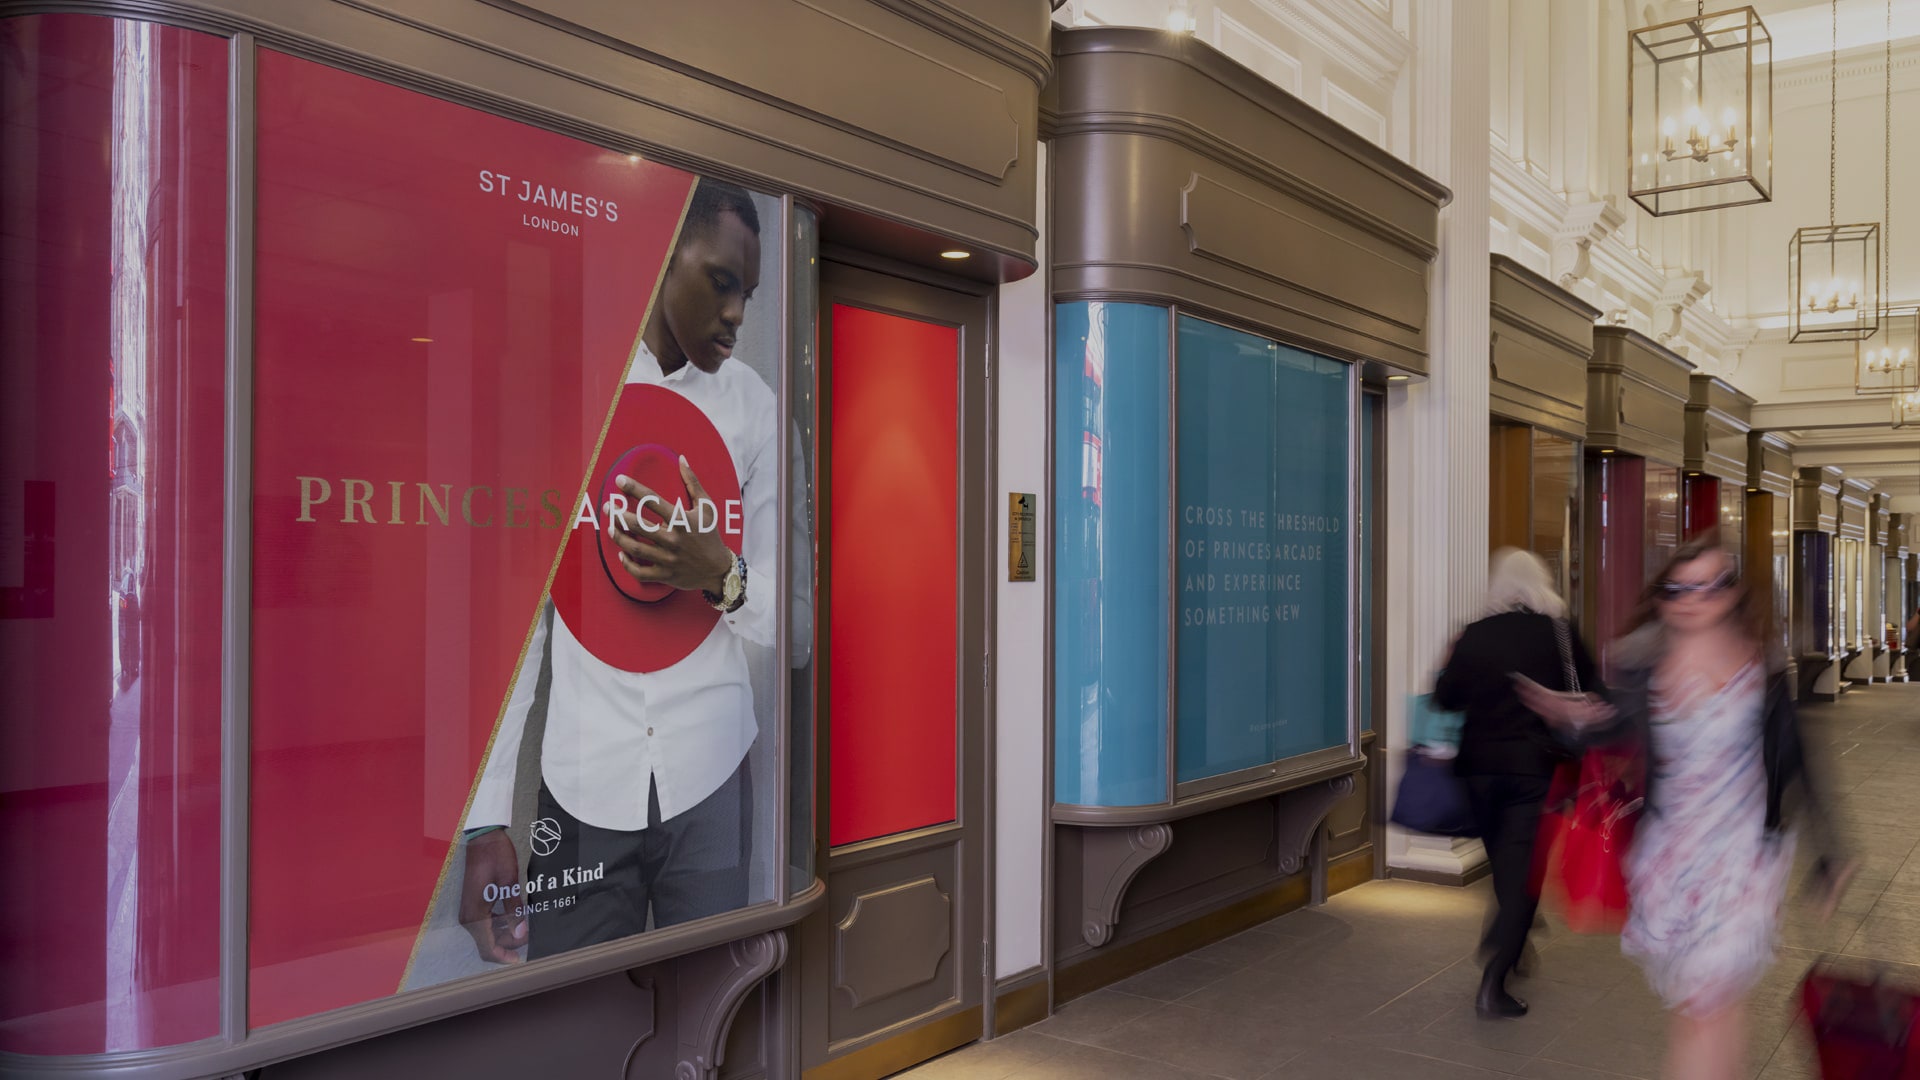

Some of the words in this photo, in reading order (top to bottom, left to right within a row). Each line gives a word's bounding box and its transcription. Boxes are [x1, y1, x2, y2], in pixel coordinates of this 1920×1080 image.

[479, 170, 511, 197] ST
[517, 180, 619, 222] JAMES'S
[523, 214, 580, 237] LONDON
[295, 476, 563, 530] PRINCES
[572, 490, 742, 535] ARCADE
[1185, 505, 1233, 527] CROSS
[1241, 510, 1265, 529] THE
[1185, 539, 1205, 558] OF
[1214, 541, 1271, 560] PRINCES
[1275, 544, 1322, 561] ARCADE
[1185, 574, 1216, 592] AND
[1185, 605, 1270, 627] SOMETHING
[483, 883, 521, 903] One
[525, 874, 544, 894] of
[547, 876, 558, 890] a
[562, 862, 604, 888] Kind
[515, 900, 550, 917] SINCE
[553, 895, 576, 909] 1661
